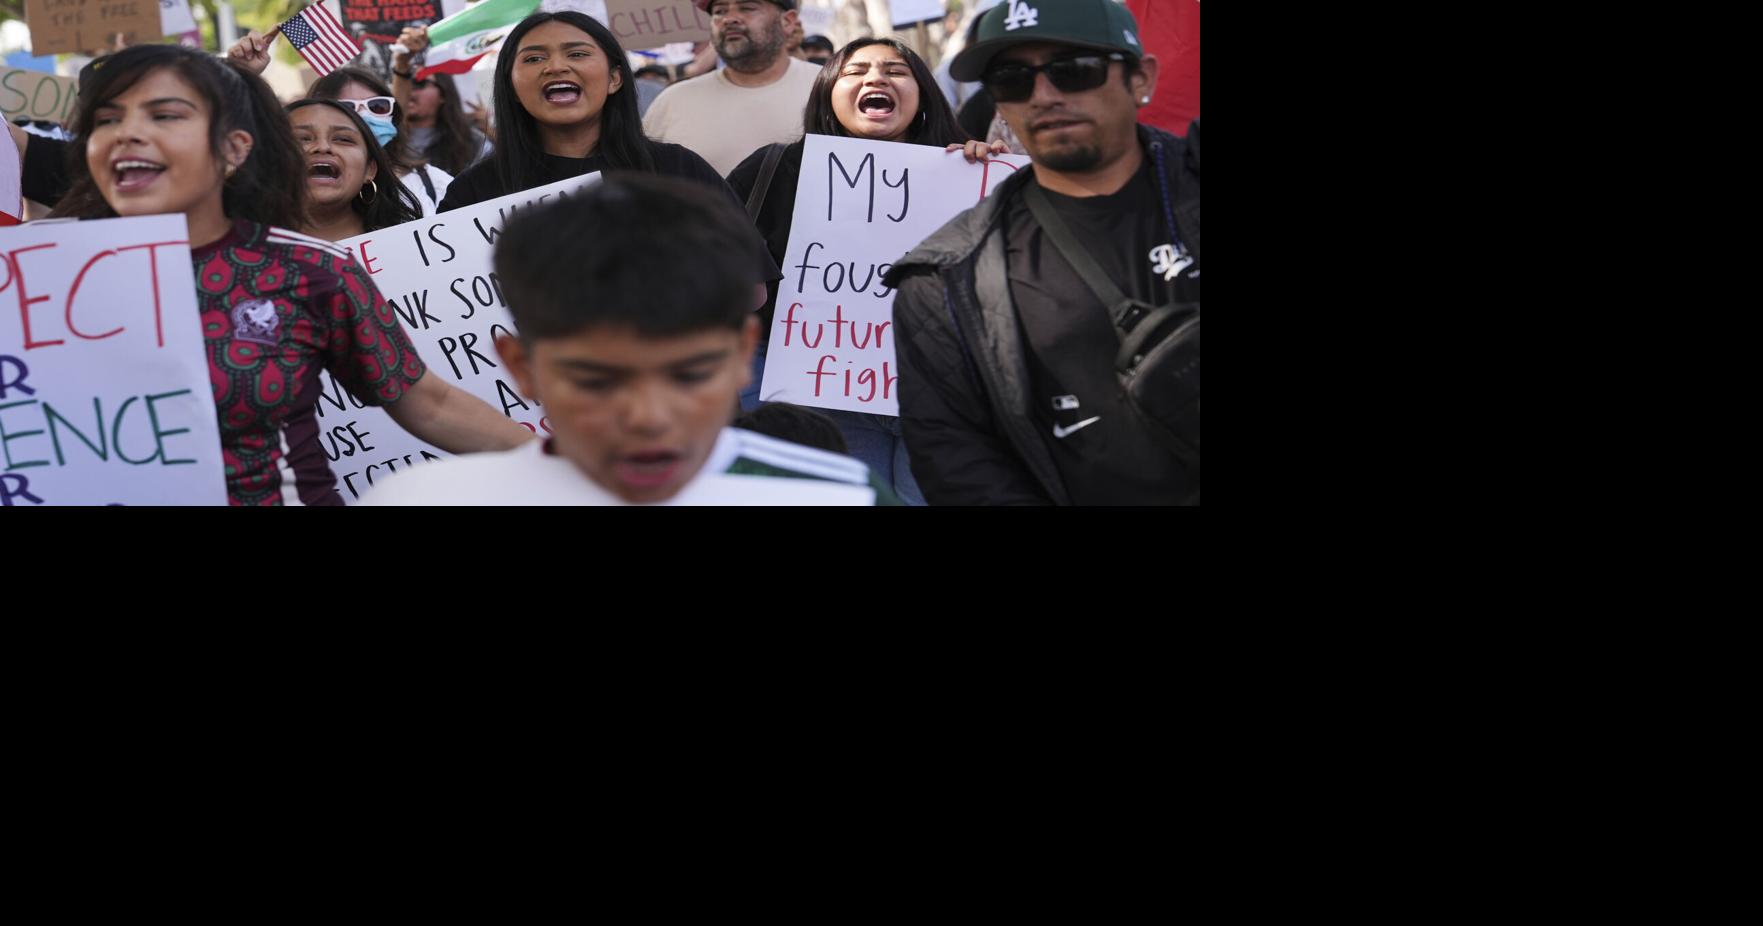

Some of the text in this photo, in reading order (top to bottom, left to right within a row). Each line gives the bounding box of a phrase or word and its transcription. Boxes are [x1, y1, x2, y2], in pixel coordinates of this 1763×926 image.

[383, 4, 436, 21] FEEDS
[829, 151, 909, 222] My
[413, 223, 455, 267] IS
